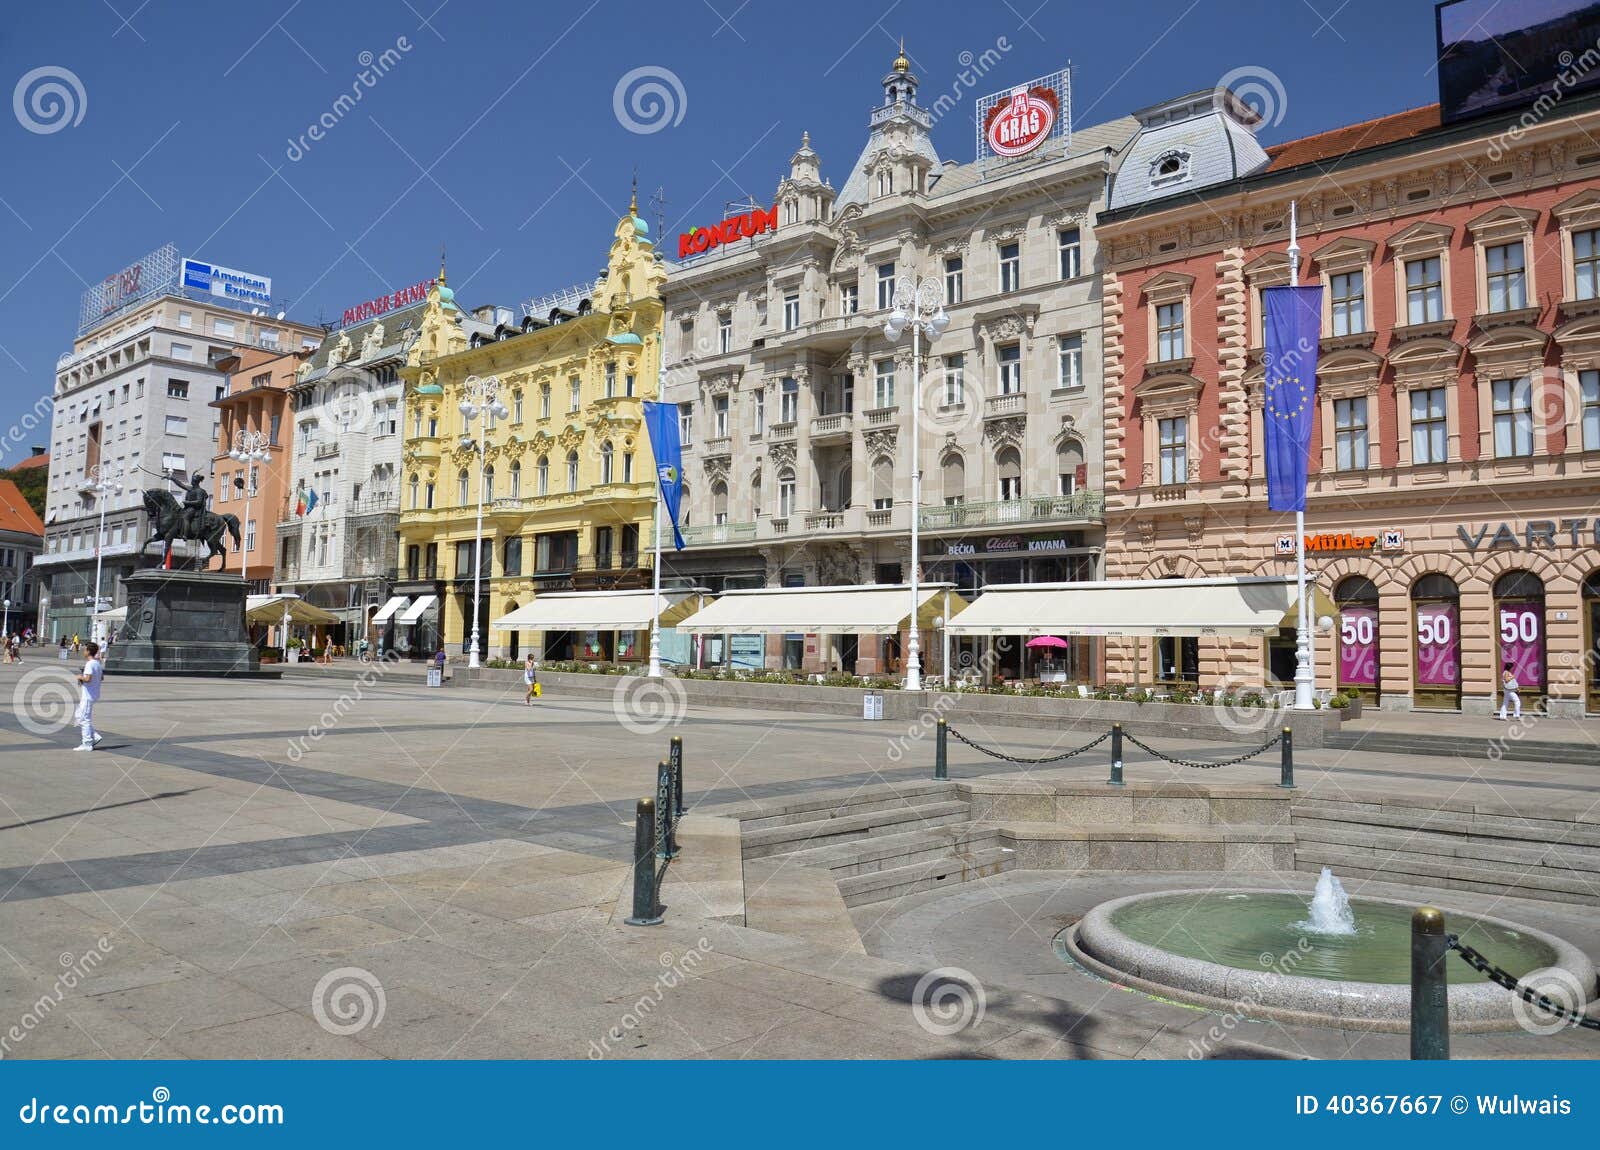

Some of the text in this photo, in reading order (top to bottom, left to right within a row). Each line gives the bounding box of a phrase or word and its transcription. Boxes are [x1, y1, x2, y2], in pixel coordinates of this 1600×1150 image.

[1000, 109, 1040, 144] KRAŠ
[678, 203, 778, 258] KONZUM
[212, 268, 266, 289] American
[224, 282, 271, 302] Express
[342, 294, 391, 327] PARTNER
[948, 543, 976, 555] BEČKA
[1028, 539, 1067, 551] KAVANA
[1304, 533, 1378, 551] Müller
[1341, 616, 1374, 645] 50
[1418, 614, 1450, 645] 50
[1500, 611, 1538, 643] 50
